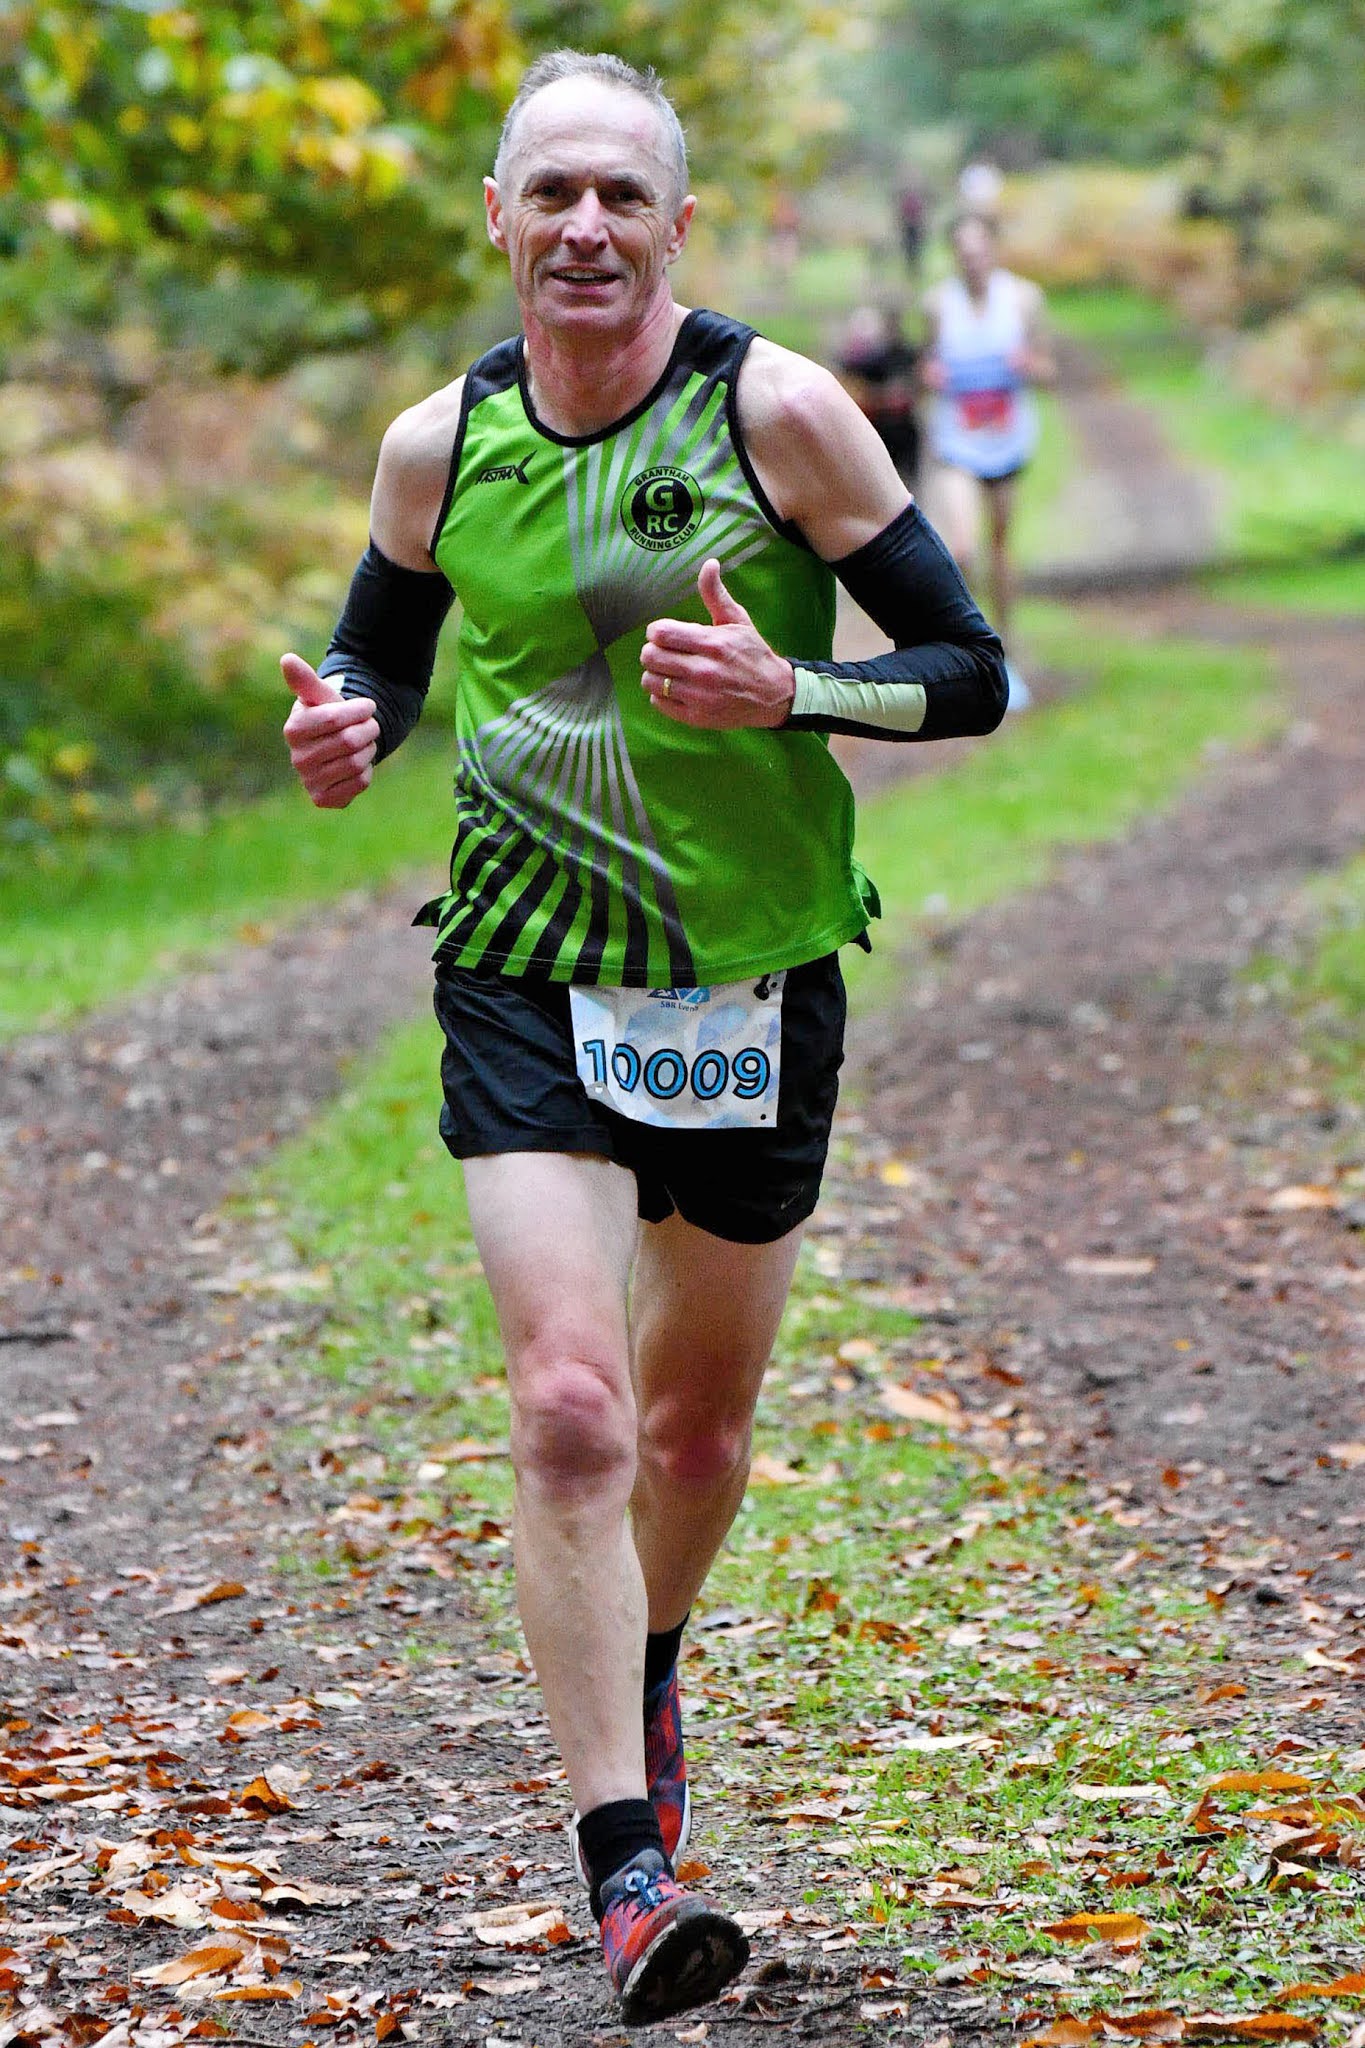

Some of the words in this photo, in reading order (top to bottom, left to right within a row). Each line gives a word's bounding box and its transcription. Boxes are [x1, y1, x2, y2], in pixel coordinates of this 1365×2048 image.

[634, 468, 690, 486] GRANTHAM
[645, 480, 675, 512] G
[630, 526, 672, 549] RUNNING
[672, 522, 696, 545] CLUB
[647, 513, 679, 534] RC
[582, 1039, 771, 1101] 10009
